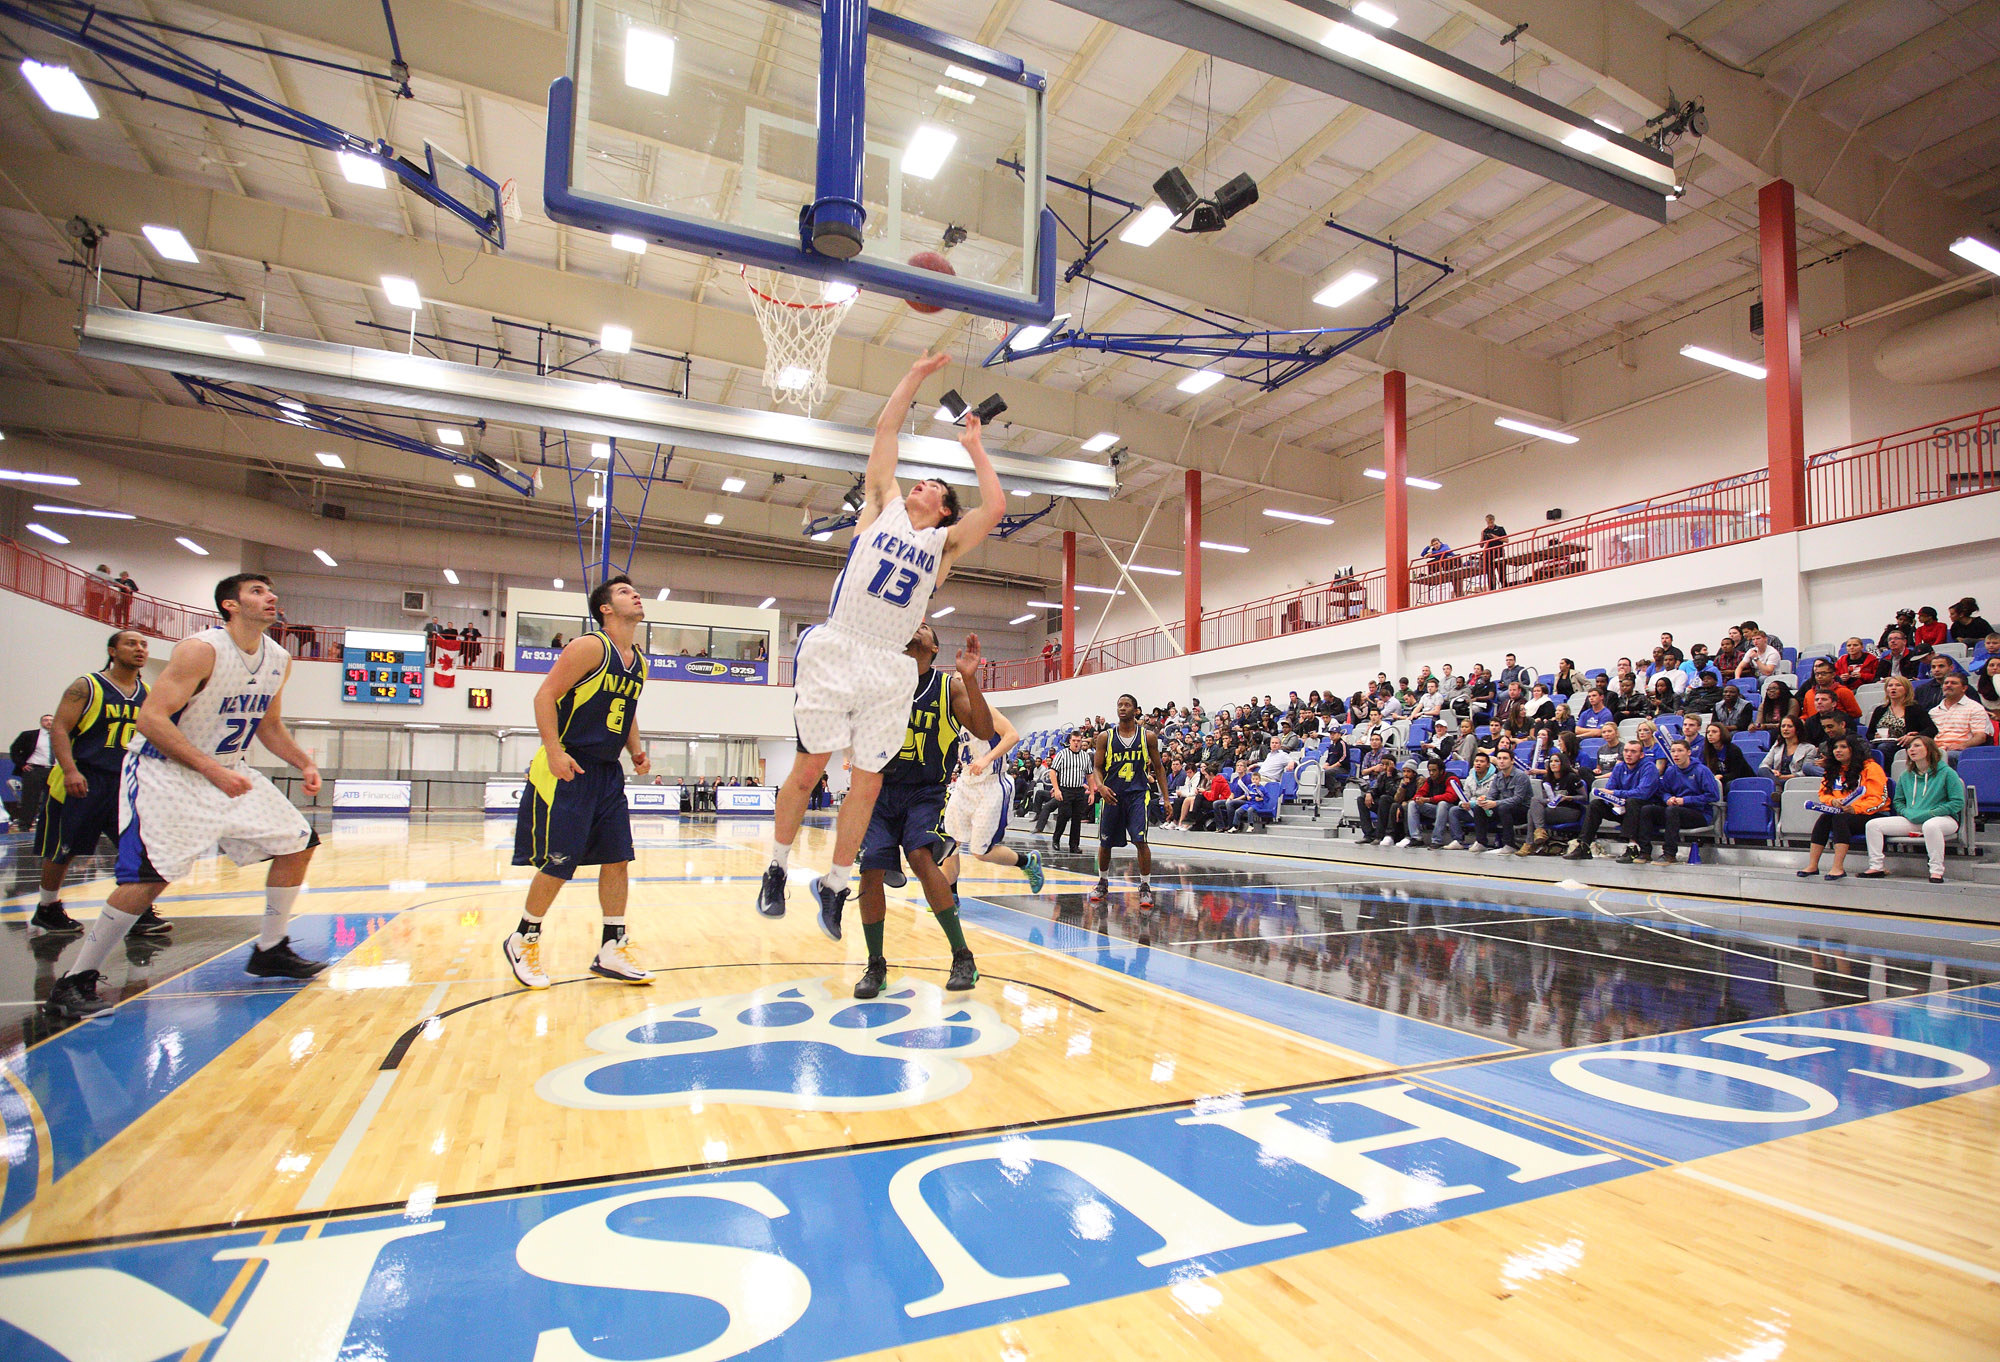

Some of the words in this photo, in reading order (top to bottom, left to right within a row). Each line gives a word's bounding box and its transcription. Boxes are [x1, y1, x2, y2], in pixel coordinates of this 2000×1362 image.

[871, 531, 935, 574] KEYANO
[867, 558, 921, 608] 13
[370, 651, 396, 663] 14.6
[534, 651, 552, 661] 93.3
[654, 659, 677, 668] 191.2%
[686, 664, 713, 672] COUNTRY
[349, 669, 368, 681] 47
[379, 671, 389, 682] 2
[403, 672, 422, 684] 27
[347, 685, 357, 696] 5
[603, 673, 642, 700] NAIT
[412, 689, 421, 698] 4
[218, 694, 274, 715] KEYAN
[105, 703, 140, 719] NAI
[104, 721, 137, 750] 10
[214, 717, 262, 755] 21
[1113, 750, 1142, 762] NAIT
[1118, 762, 1135, 782] 4
[342, 791, 360, 799] ATB
[733, 796, 759, 804] TODAY
[1550, 1026, 1989, 1123] GO
